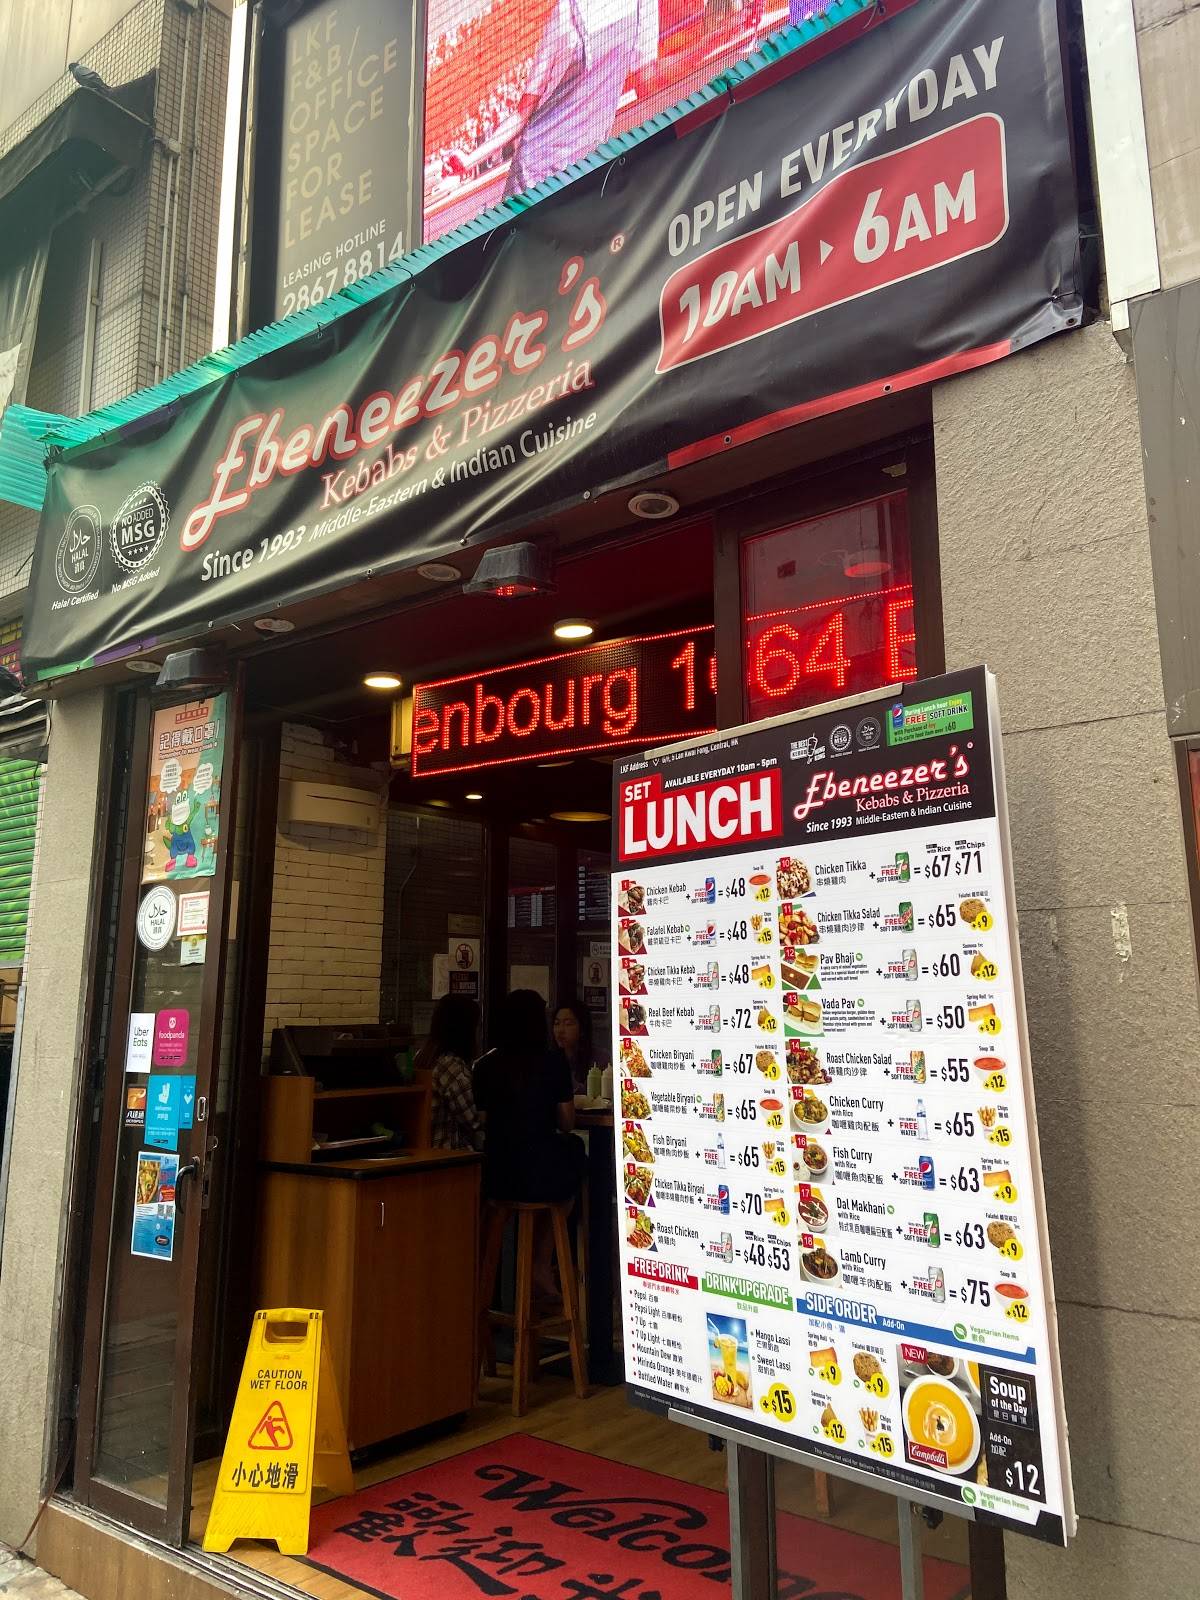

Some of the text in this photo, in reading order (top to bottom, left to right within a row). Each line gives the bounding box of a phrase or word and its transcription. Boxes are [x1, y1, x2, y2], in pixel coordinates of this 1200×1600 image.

[292, 10, 340, 66] LKF
[289, 38, 398, 135] OFFICE
[288, 86, 385, 174] SPACE
[668, 36, 1005, 257] OPEN EVERYDAY
[287, 152, 343, 211] FOR
[284, 169, 374, 249] LEASE
[283, 218, 387, 289] LEASING HOTLINE
[679, 169, 977, 344] 10AM 6AM
[181, 257, 607, 551] Ebeneezer's
[320, 358, 595, 512] Kebabs & Pizzeria
[201, 411, 597, 581] Since 1993 Middle-Eastern & Indian Cuisine
[121, 520, 155, 546] MSG
[111, 567, 160, 594] No MSG Added
[52, 589, 100, 610] Halal Certified
[905, 704, 968, 725] FREE SOFT DRINK
[620, 760, 649, 774] LKF Address
[664, 772, 700, 789] AVAILABLE
[701, 765, 736, 781] EVERYDAY
[737, 762, 756, 773] 10am
[624, 781, 652, 803] SET
[793, 746, 971, 820] Ebeneezer's
[855, 781, 970, 812] Kebabs & Pizzeria
[624, 777, 773, 855] LUNCH
[806, 800, 972, 833] Since 1993 Middle-Eastern & Indian Cuisine
[815, 860, 867, 876] Chicken Tikka
[925, 851, 982, 878] $67 $71
[646, 883, 687, 896] Chicken Kebab
[725, 877, 746, 899] $48
[150, 919, 166, 927] HALAL
[817, 907, 881, 923] Chicken Tikka Salad
[928, 904, 956, 928] $65
[646, 923, 685, 936] Falafel Kebab
[727, 920, 747, 941] $48
[820, 951, 855, 964] Pav Bhaji
[932, 953, 961, 977] $60
[647, 965, 696, 976] Chicken Tikka Kebab
[729, 964, 749, 985] $48
[648, 1007, 695, 1018] Real Beef Kebab
[821, 998, 856, 1009] Vada Pav
[731, 1008, 752, 1030] $72
[936, 1005, 965, 1030] $50
[132, 1037, 148, 1048] Eats
[133, 1026, 150, 1038] Uber
[158, 1031, 185, 1041] foodpanda
[649, 1050, 695, 1062] Chicken Biryani
[733, 1053, 754, 1075] $67
[826, 1052, 892, 1066] Roast Chicken Salad
[941, 1058, 970, 1083] $55
[650, 1091, 696, 1105] Vegetable Biryani
[829, 1096, 884, 1112] Chicken Curry
[735, 1099, 757, 1121] $65
[946, 1112, 975, 1137] $65
[652, 1134, 687, 1148] Fish Biryani
[738, 1146, 760, 1168] $65
[833, 1147, 873, 1164] Fish Curry
[654, 1178, 705, 1196] Chicken Tikka Biryani
[950, 1166, 980, 1193] $63
[740, 1193, 763, 1216] $70
[836, 1197, 886, 1215] Dal Makhani
[656, 1222, 699, 1240] Roast Chicken
[955, 1222, 986, 1250] $63
[743, 1243, 790, 1272] $48 $53
[840, 1249, 887, 1270] Lamb Curry
[633, 1256, 690, 1284] FREE DRINK
[634, 1288, 647, 1301] Pepsi
[705, 1271, 789, 1305] DRINK UPGRADE
[961, 1279, 991, 1308] $75
[805, 1291, 905, 1332] SIDE ORDER Add-On
[755, 1328, 791, 1346] Mango Lassi
[904, 1345, 926, 1361] NEW
[250, 1380, 308, 1391] WET FLOOR
[257, 1369, 303, 1380] CAUTION
[989, 1375, 1027, 1403] Soup
[991, 1399, 1028, 1416] of the Day
[989, 1431, 1013, 1446] Add-On
[232, 1461, 299, 1490] 小心地滑
[1005, 1461, 1041, 1496] $12
